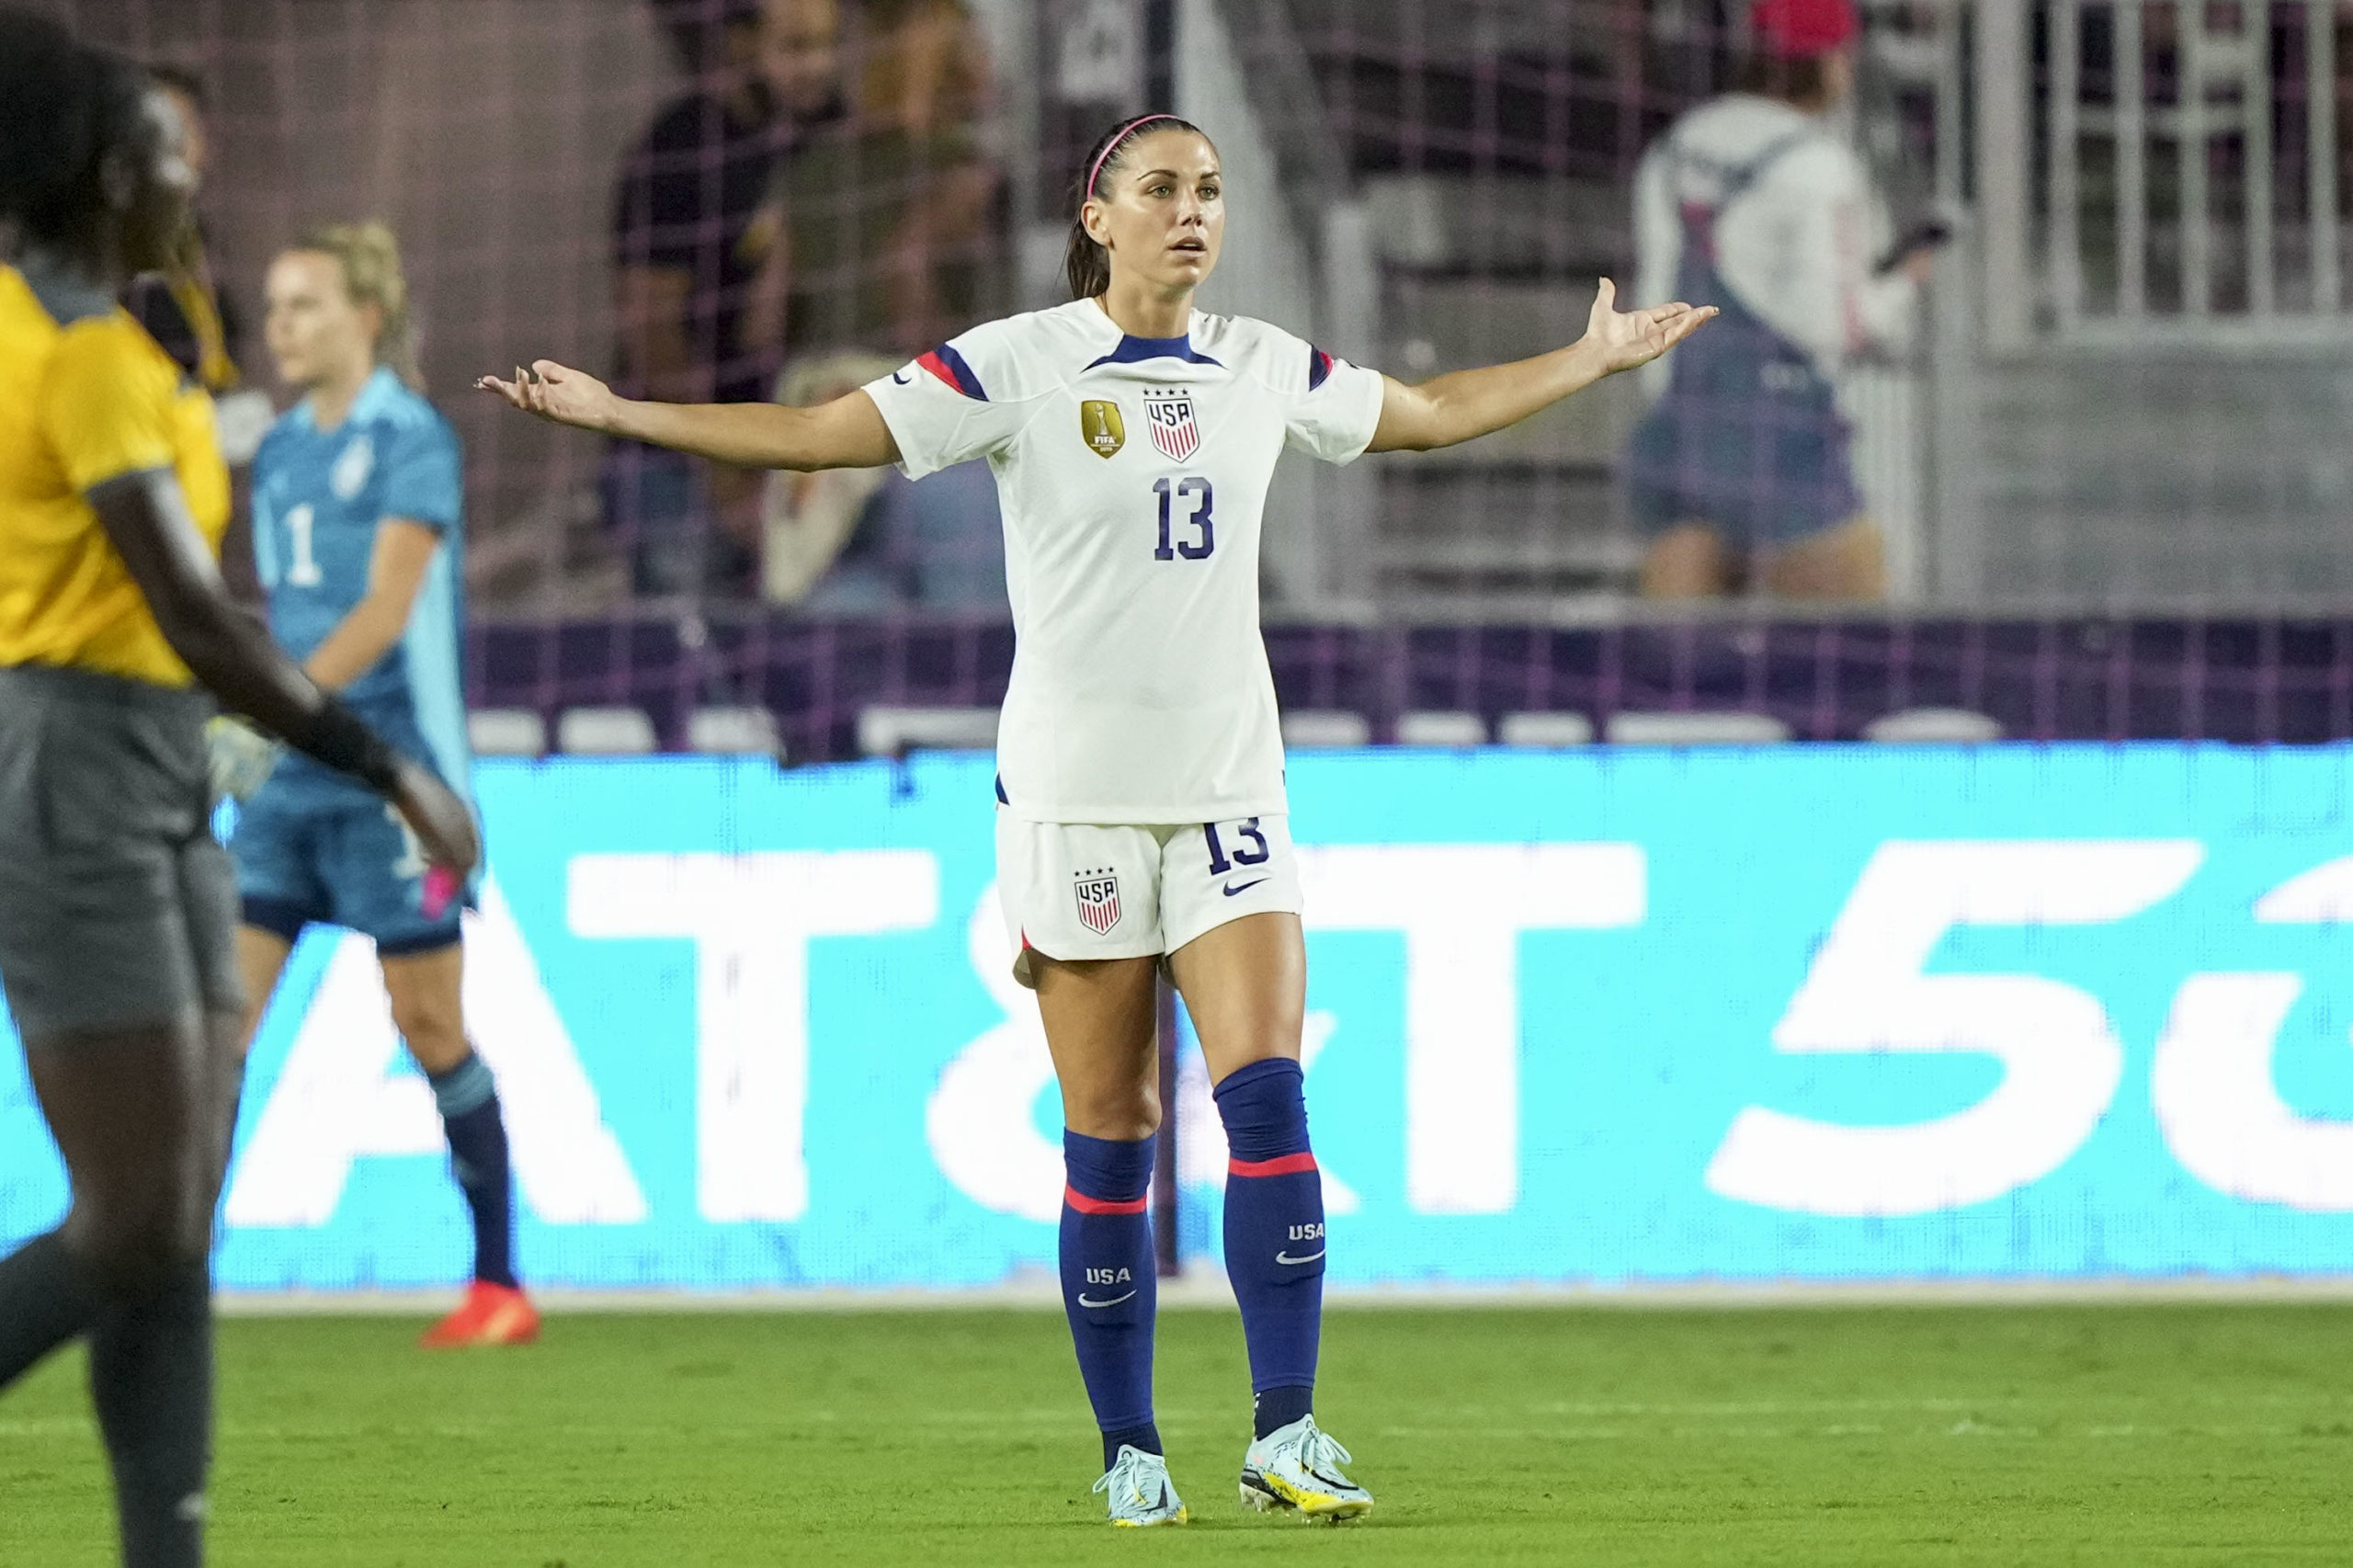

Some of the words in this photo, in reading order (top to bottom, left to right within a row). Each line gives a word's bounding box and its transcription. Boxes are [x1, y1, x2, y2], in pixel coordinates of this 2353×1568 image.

[1148, 403, 1190, 426] USA
[1094, 435, 1116, 445] FIFA
[1152, 476, 1215, 561] 13
[284, 503, 323, 587] 1
[1202, 816, 1270, 876] 13
[1078, 881, 1116, 903] USA
[1289, 1223, 1325, 1242] USA
[1086, 1267, 1131, 1286] USA
